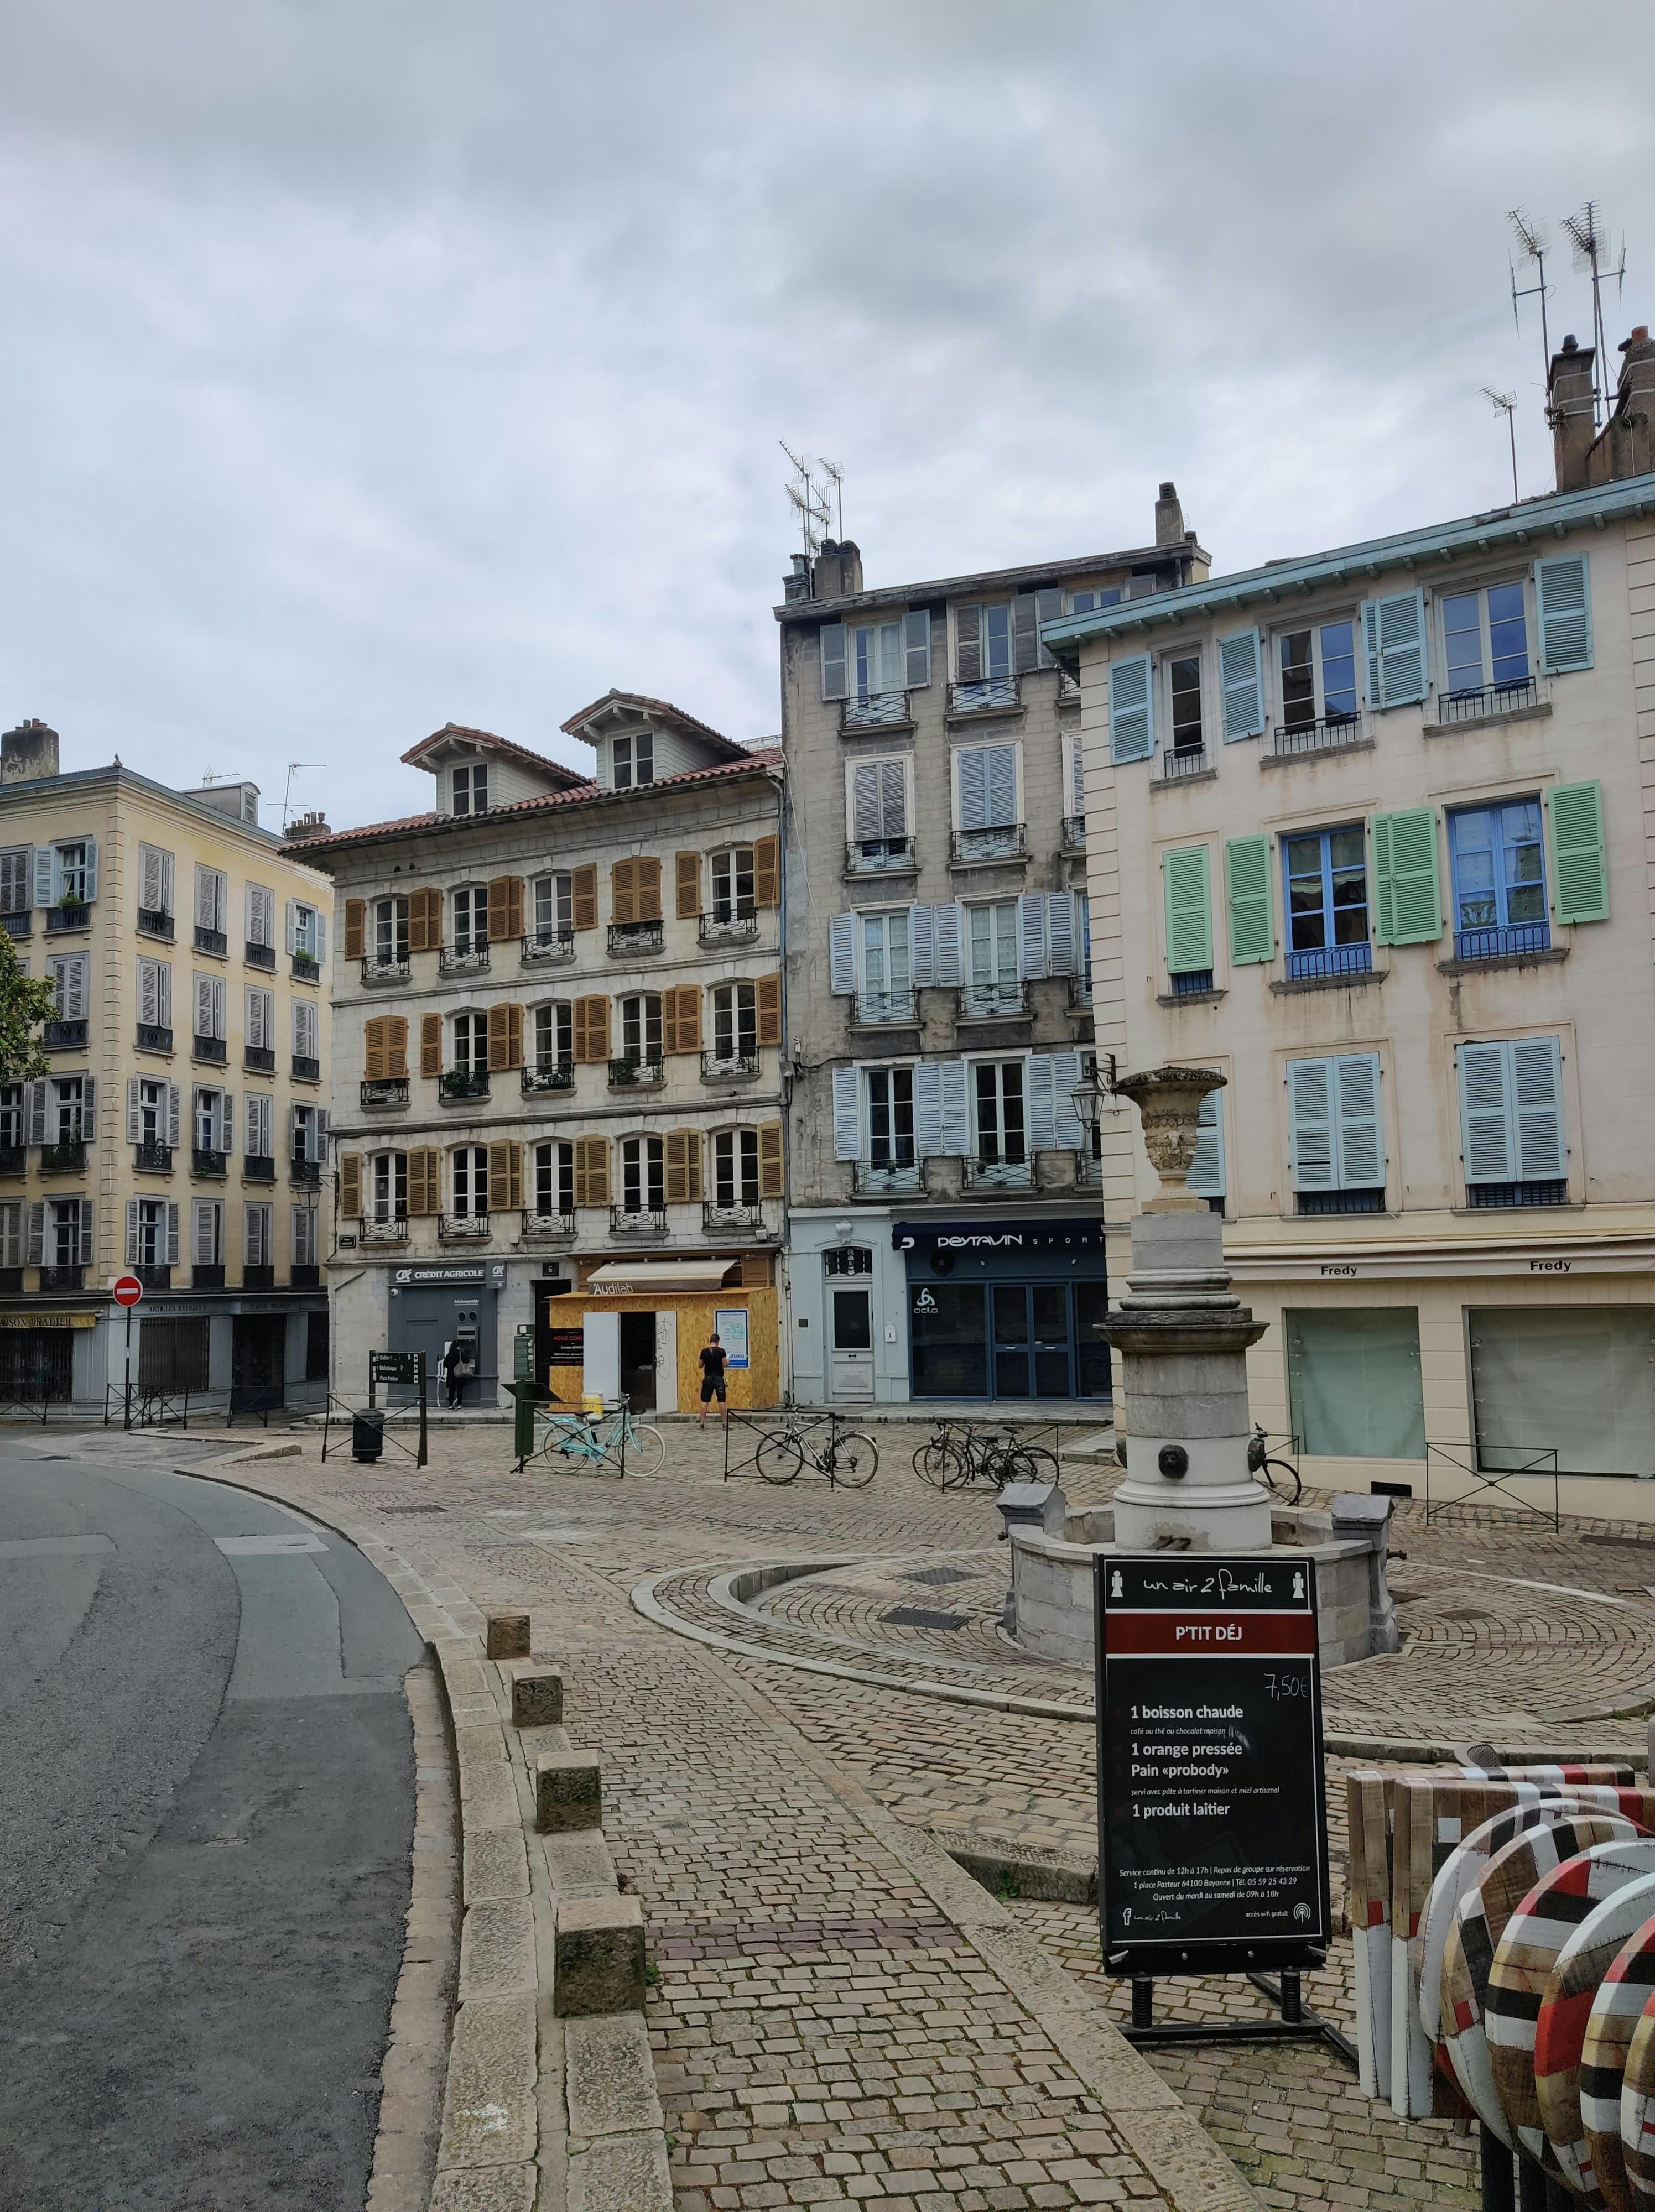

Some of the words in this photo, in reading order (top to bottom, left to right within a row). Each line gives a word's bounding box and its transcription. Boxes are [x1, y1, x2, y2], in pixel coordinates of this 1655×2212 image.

[1321, 1266, 1357, 1277] Fredy
[1530, 1260, 1571, 1272] Fredy
[415, 1270, 443, 1279] CRÉDIT
[444, 1270, 484, 1278] AGRICOLE
[1143, 1579, 1168, 1590] un
[1172, 1579, 1198, 1592] air
[1200, 1577, 1215, 1593] 2
[1218, 1568, 1272, 1600] famille
[1175, 1626, 1212, 1640] P'TIT
[1216, 1624, 1242, 1640] DÉJ
[1263, 1673, 1309, 1702] 7,50€
[1131, 1705, 1139, 1719] 1
[1142, 1705, 1193, 1719] boisson
[1196, 1704, 1243, 1718] chaude
[1130, 1727, 1144, 1735] café
[1131, 1743, 1139, 1756] 1
[1143, 1745, 1189, 1758] orange
[1192, 1742, 1243, 1758] pressée
[1132, 1764, 1159, 1777] Pain
[1162, 1763, 1229, 1778] «probody»
[1162, 1788, 1177, 1796] pâte
[1132, 1804, 1140, 1817] 1
[1143, 1803, 1190, 1819] produit
[1193, 1802, 1230, 1815] laitier
[1214, 1866, 1232, 1875] Repas
[1139, 1881, 1156, 1890] place
[1204, 1879, 1231, 1887] Bayonne
